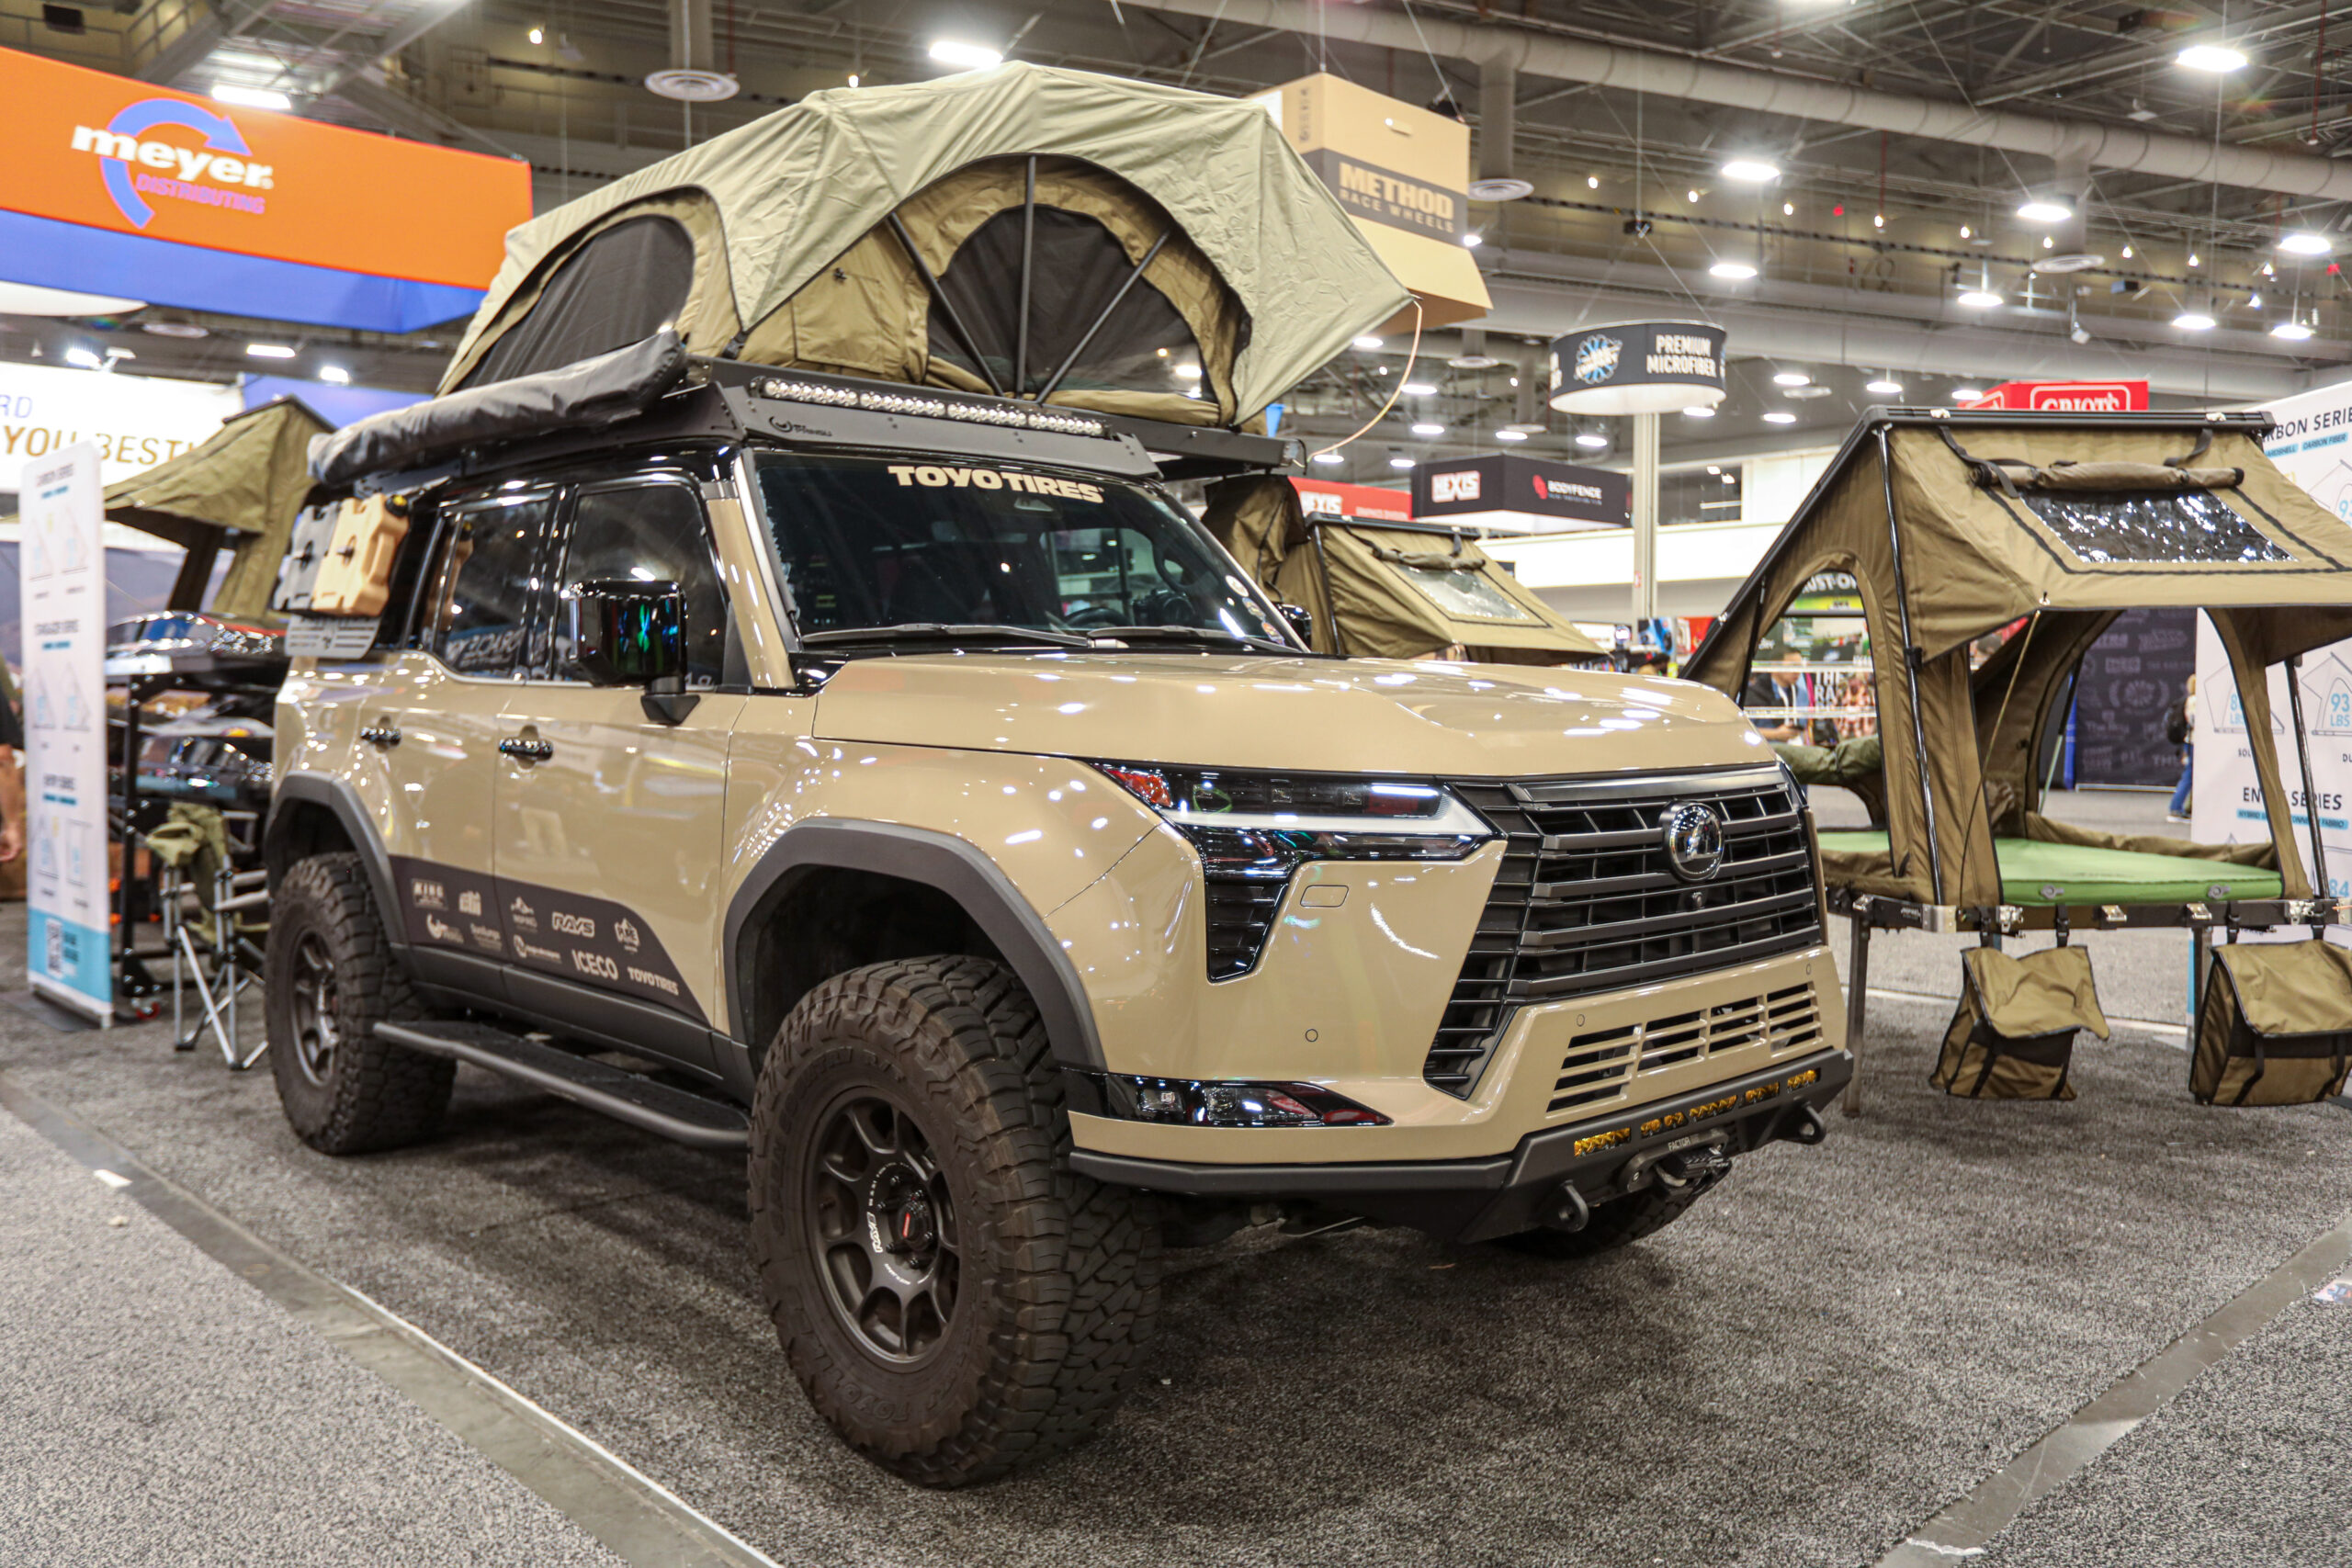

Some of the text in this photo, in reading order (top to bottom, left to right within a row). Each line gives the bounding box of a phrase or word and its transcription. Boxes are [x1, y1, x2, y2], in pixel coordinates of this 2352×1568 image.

[70, 124, 274, 189] meyer
[135, 174, 266, 215] DISTRIBUTING
[1339, 161, 1454, 221] METHOD
[1339, 189, 1454, 234] RACE WHEELS
[1656, 333, 1712, 357] PREMIUM
[1646, 354, 1717, 378] MICROFIBER
[2264, 418, 2308, 443] RBON
[1431, 470, 1481, 503] HEXIS
[1548, 479, 1603, 500] BODYFENCE
[1299, 491, 1343, 516] HEXIS
[2330, 693, 2350, 712] 93
[2330, 715, 2350, 727] LBS
[413, 882, 445, 897] KING
[552, 912, 594, 938] RAYS
[571, 949, 618, 981] ICECO
[1668, 1136, 1691, 1151] FACTOR
[866, 1211, 884, 1253] RAYS
